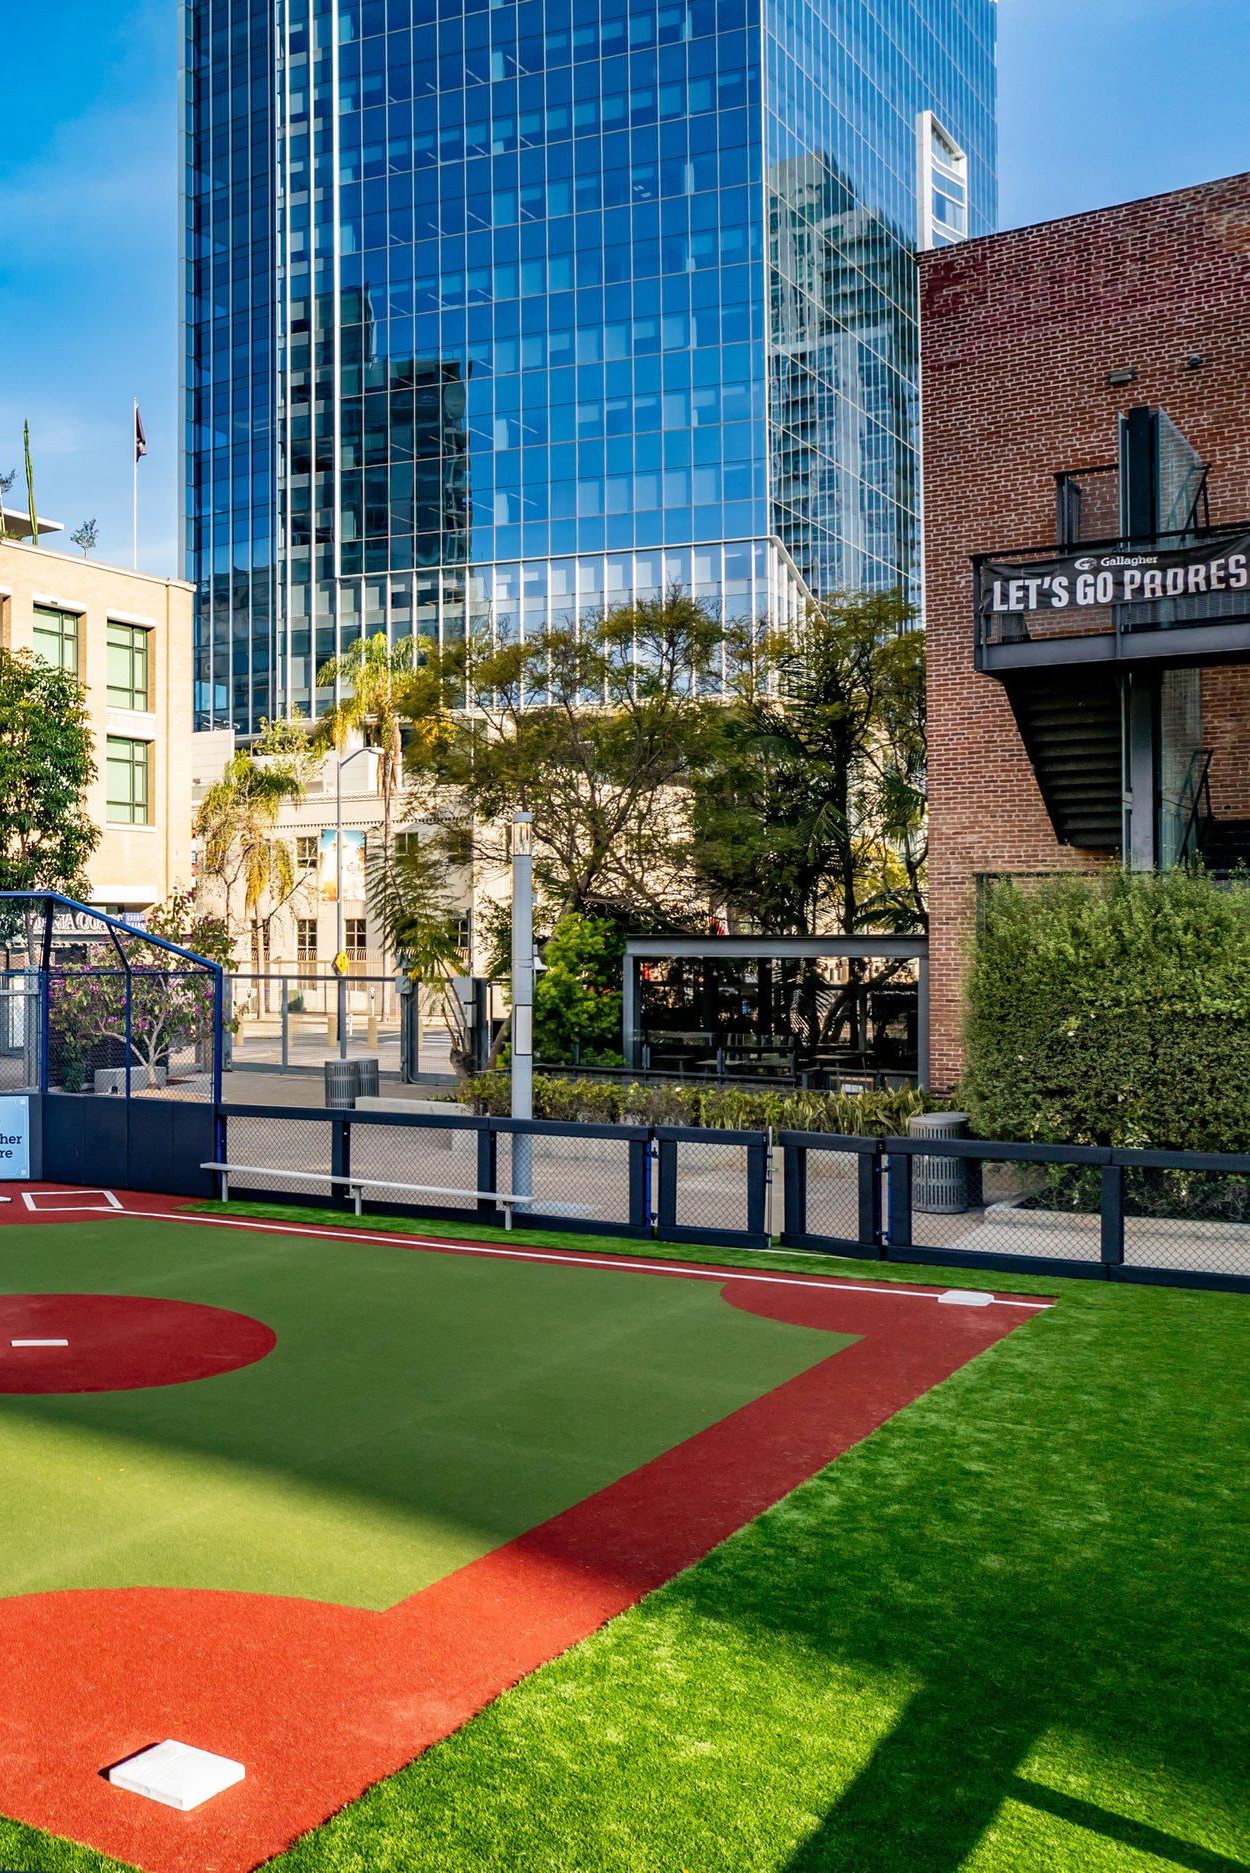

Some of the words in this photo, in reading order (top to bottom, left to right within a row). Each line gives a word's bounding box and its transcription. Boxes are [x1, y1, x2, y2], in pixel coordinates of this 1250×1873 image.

[1101, 555, 1158, 567] Gallagher
[993, 576, 1069, 611] LET'S
[1076, 571, 1113, 606] GO
[1123, 554, 1248, 600] PADRES
